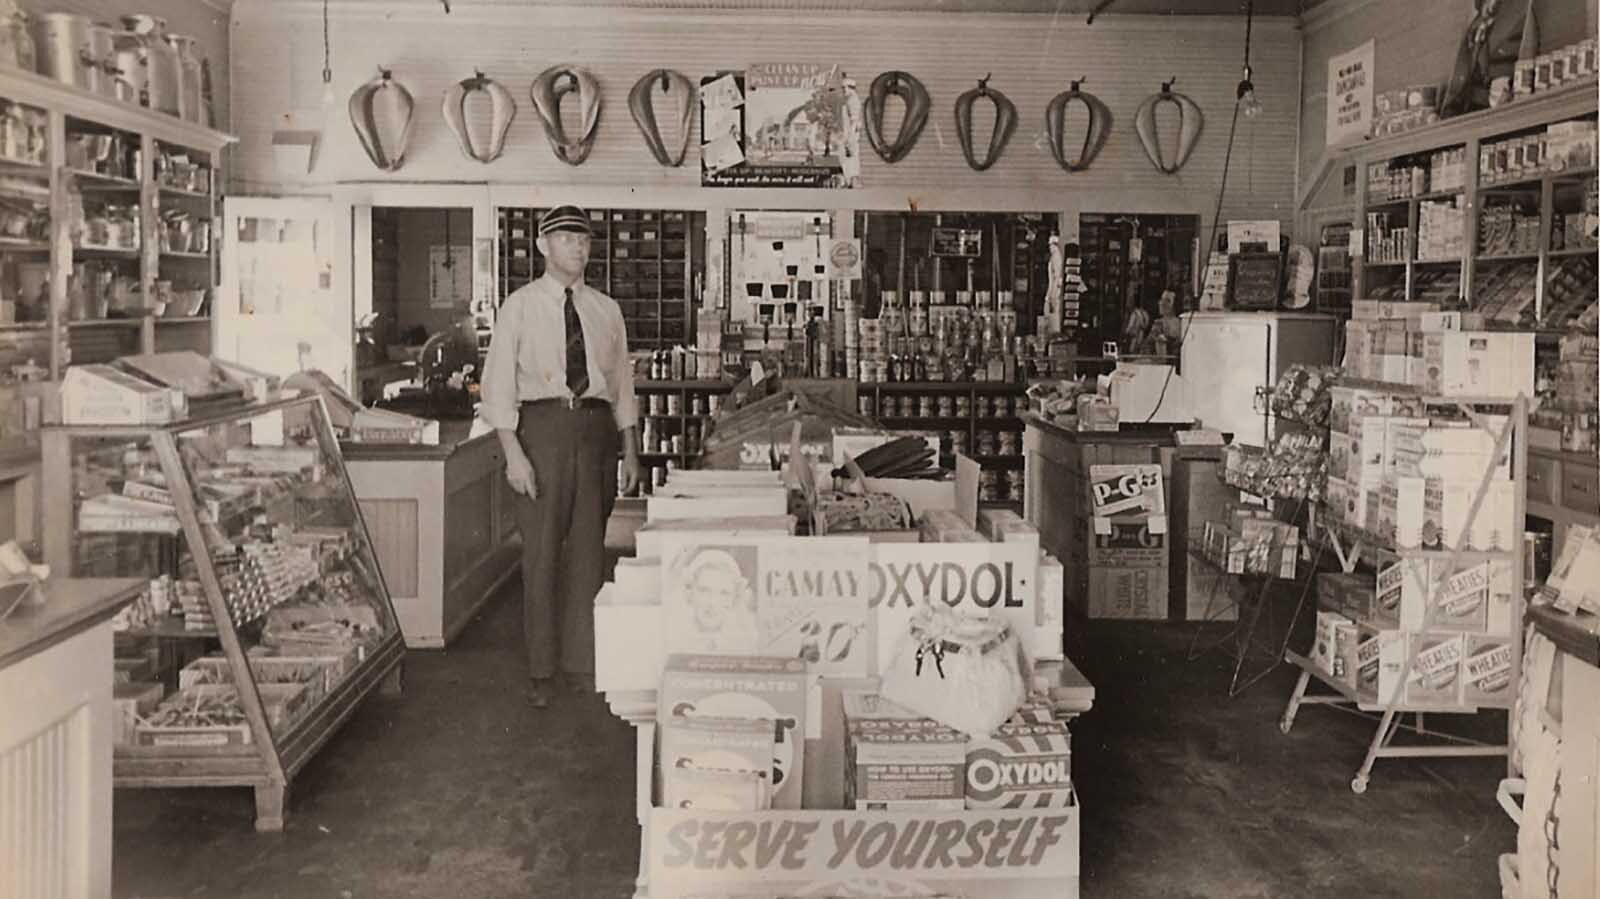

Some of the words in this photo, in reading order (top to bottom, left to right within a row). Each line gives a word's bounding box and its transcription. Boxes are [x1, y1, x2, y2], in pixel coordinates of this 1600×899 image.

[724, 323, 743, 335] LUX
[722, 352, 742, 366] LUX
[766, 568, 861, 598] CAMAY
[869, 561, 1024, 608] OXYDOL
[967, 757, 1070, 793] OXYDOL
[664, 820, 819, 870] SERVE
[826, 815, 1069, 870] YOURSELF
